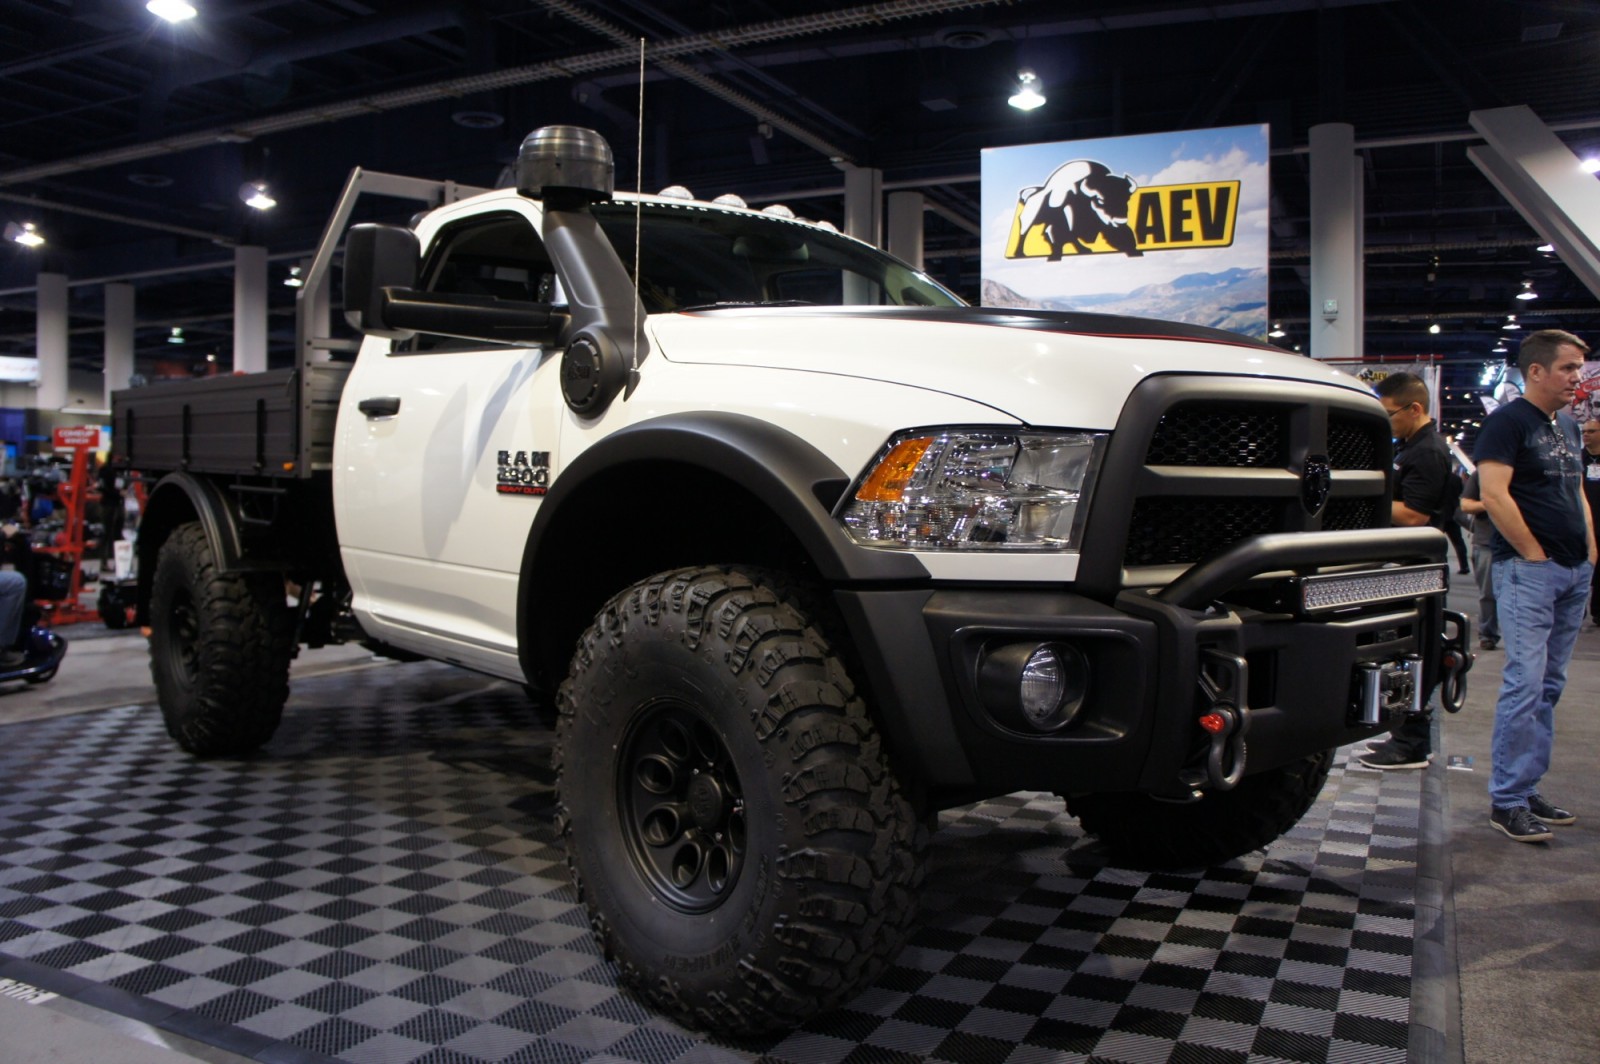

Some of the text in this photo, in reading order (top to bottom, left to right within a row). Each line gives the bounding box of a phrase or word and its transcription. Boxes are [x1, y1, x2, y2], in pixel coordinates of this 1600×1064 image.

[1136, 186, 1231, 244] AEV
[498, 450, 550, 467] RAM
[498, 484, 547, 495] HEAVY DUTY
